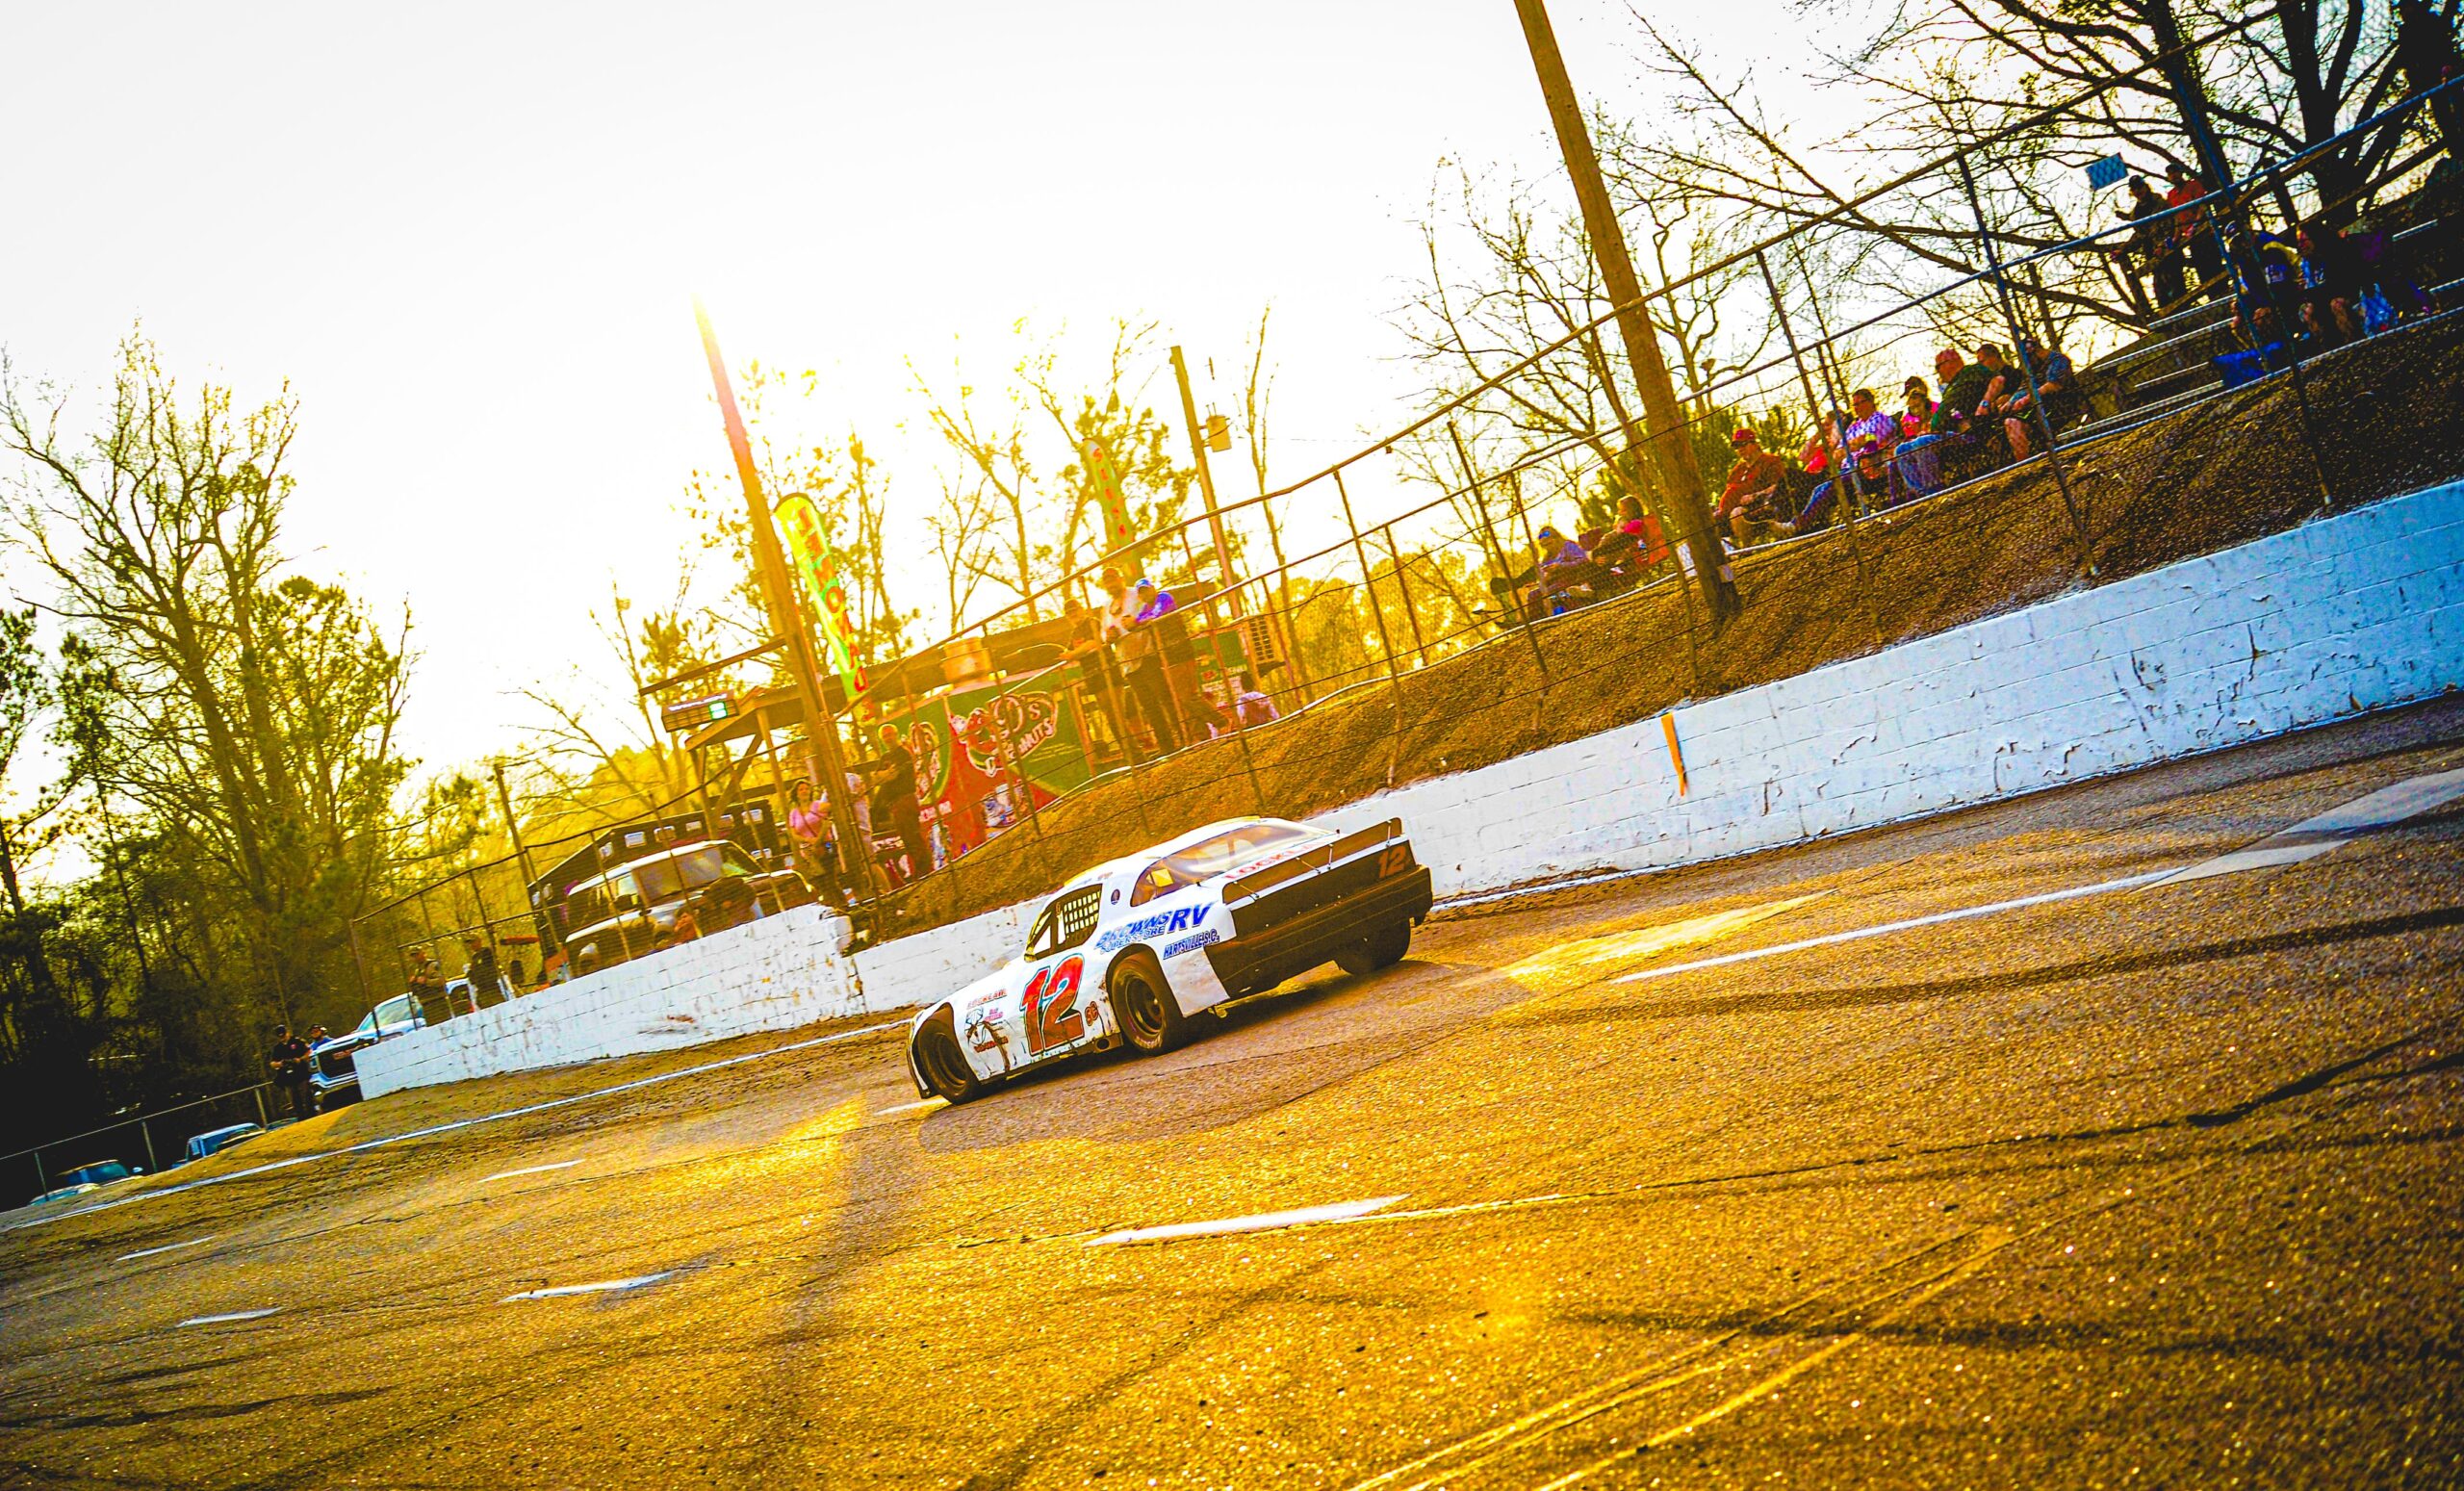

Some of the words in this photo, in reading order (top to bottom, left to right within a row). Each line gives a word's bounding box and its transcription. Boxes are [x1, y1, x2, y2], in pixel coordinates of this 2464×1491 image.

[1378, 845, 1406, 879] 12
[1168, 900, 1219, 935] RV
[1019, 953, 1085, 1057] 12
